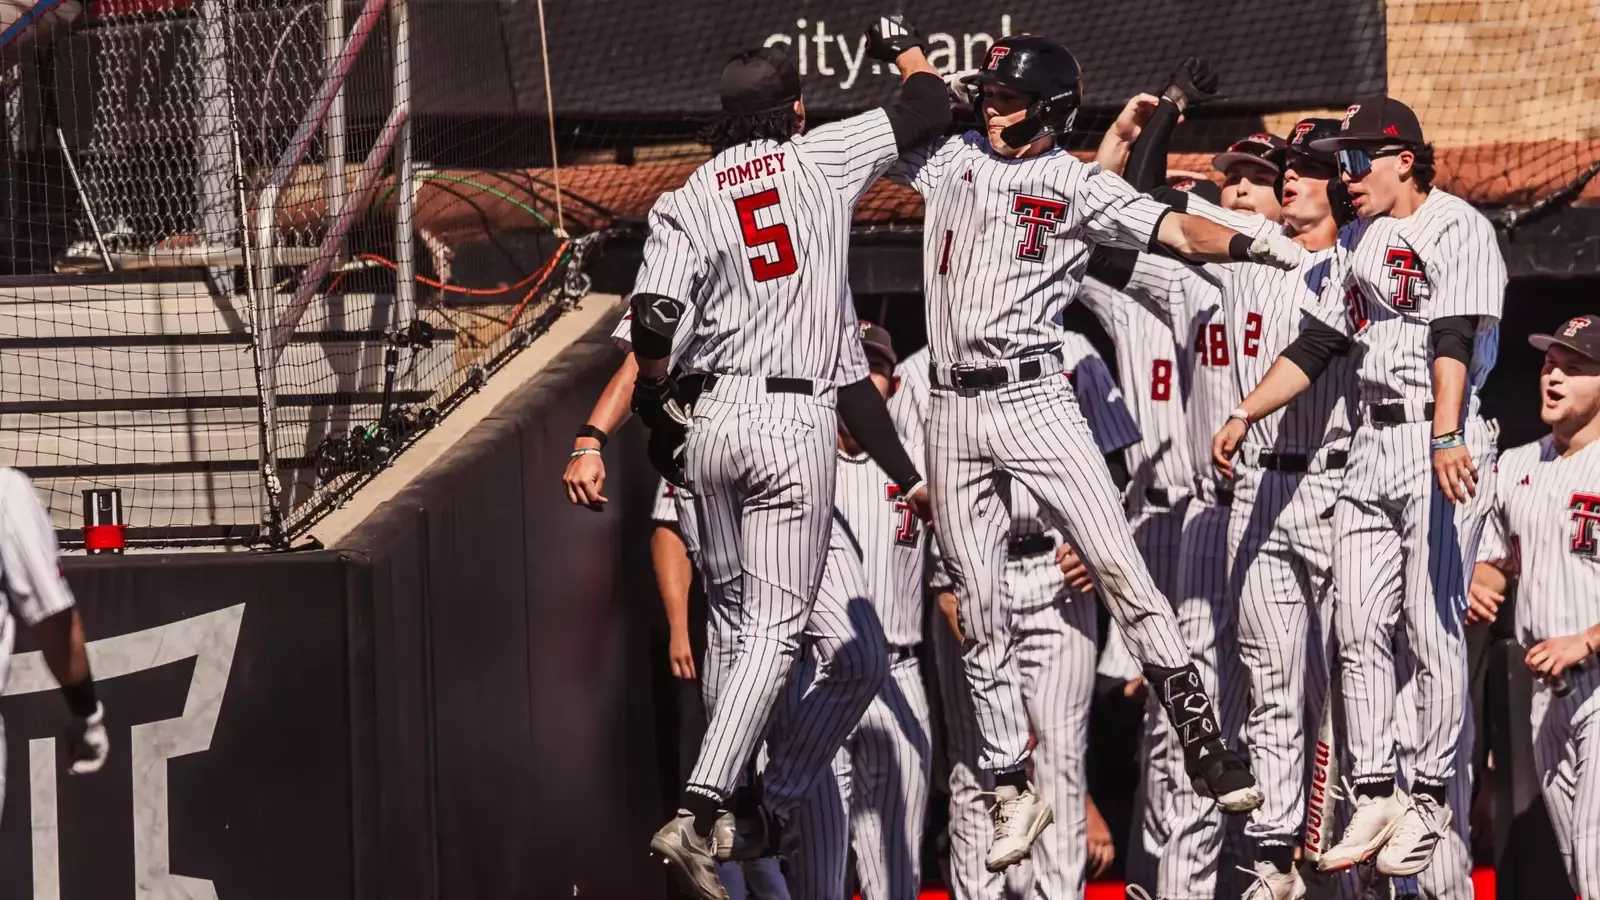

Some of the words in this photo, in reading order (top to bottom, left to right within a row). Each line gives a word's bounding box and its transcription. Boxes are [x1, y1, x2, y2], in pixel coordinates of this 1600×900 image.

[715, 152, 786, 191] POMPEY
[733, 187, 798, 282] 5
[1244, 312, 1262, 358] 2
[1151, 359, 1173, 401] 8
[1304, 739, 1330, 854] marucci
